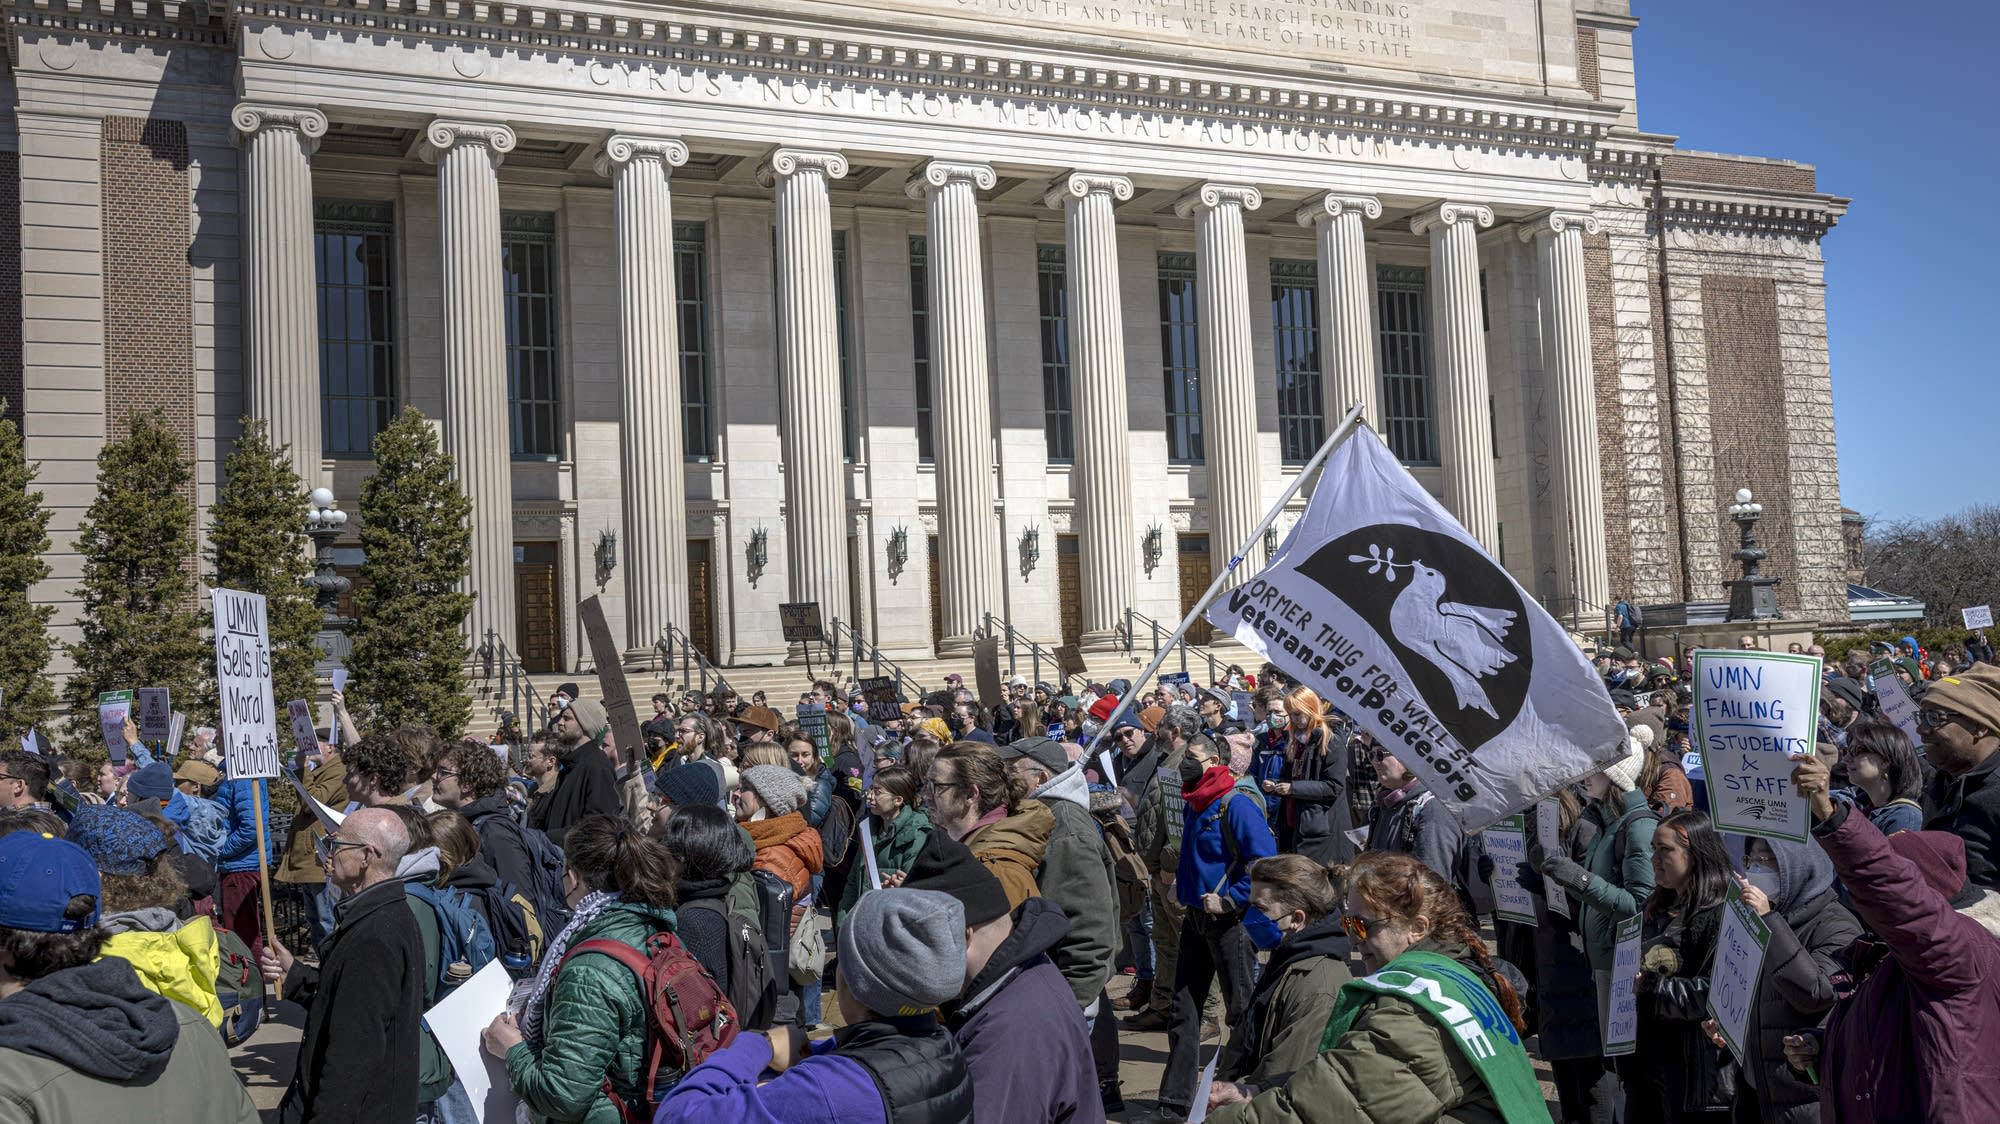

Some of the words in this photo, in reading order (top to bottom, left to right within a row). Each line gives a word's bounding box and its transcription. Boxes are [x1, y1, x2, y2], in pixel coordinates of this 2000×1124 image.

[1080, 5, 1121, 22] AND
[1132, 11, 1170, 29] THE
[1182, 17, 1271, 42] WELFARE
[1281, 29, 1303, 45] OF
[1314, 33, 1348, 50] THE
[1358, 39, 1413, 59] STATE
[1229, 2, 1301, 25] SEARCH
[1311, 13, 1344, 30] FOR
[1354, 18, 1410, 39] TRUTH
[589, 62, 722, 97] CYRUS
[762, 81, 967, 119] NORTHROP
[998, 104, 1169, 139] MEMORIAL
[1199, 122, 1390, 160] AUDITORIUM
[225, 595, 259, 634] UMN
[221, 635, 253, 678] Sells
[255, 638, 270, 679] its
[1228, 587, 1477, 802] VeteransForPeace.org
[1708, 665, 1763, 691] UMN
[228, 682, 265, 726] Moral
[1314, 623, 1364, 667] THUG
[1361, 663, 1398, 699] FOR
[1402, 699, 1449, 748] WALL
[1449, 748, 1480, 774] ST.
[1703, 697, 1785, 721] FAILING
[228, 732, 279, 778] Authority
[1709, 734, 1808, 754] STUDENTS
[1742, 753, 1760, 772] &
[1724, 774, 1788, 796] STAFF
[1736, 796, 1766, 806] AFSCME
[1767, 799, 1787, 808] UMN
[1724, 925, 1749, 961] MEET
